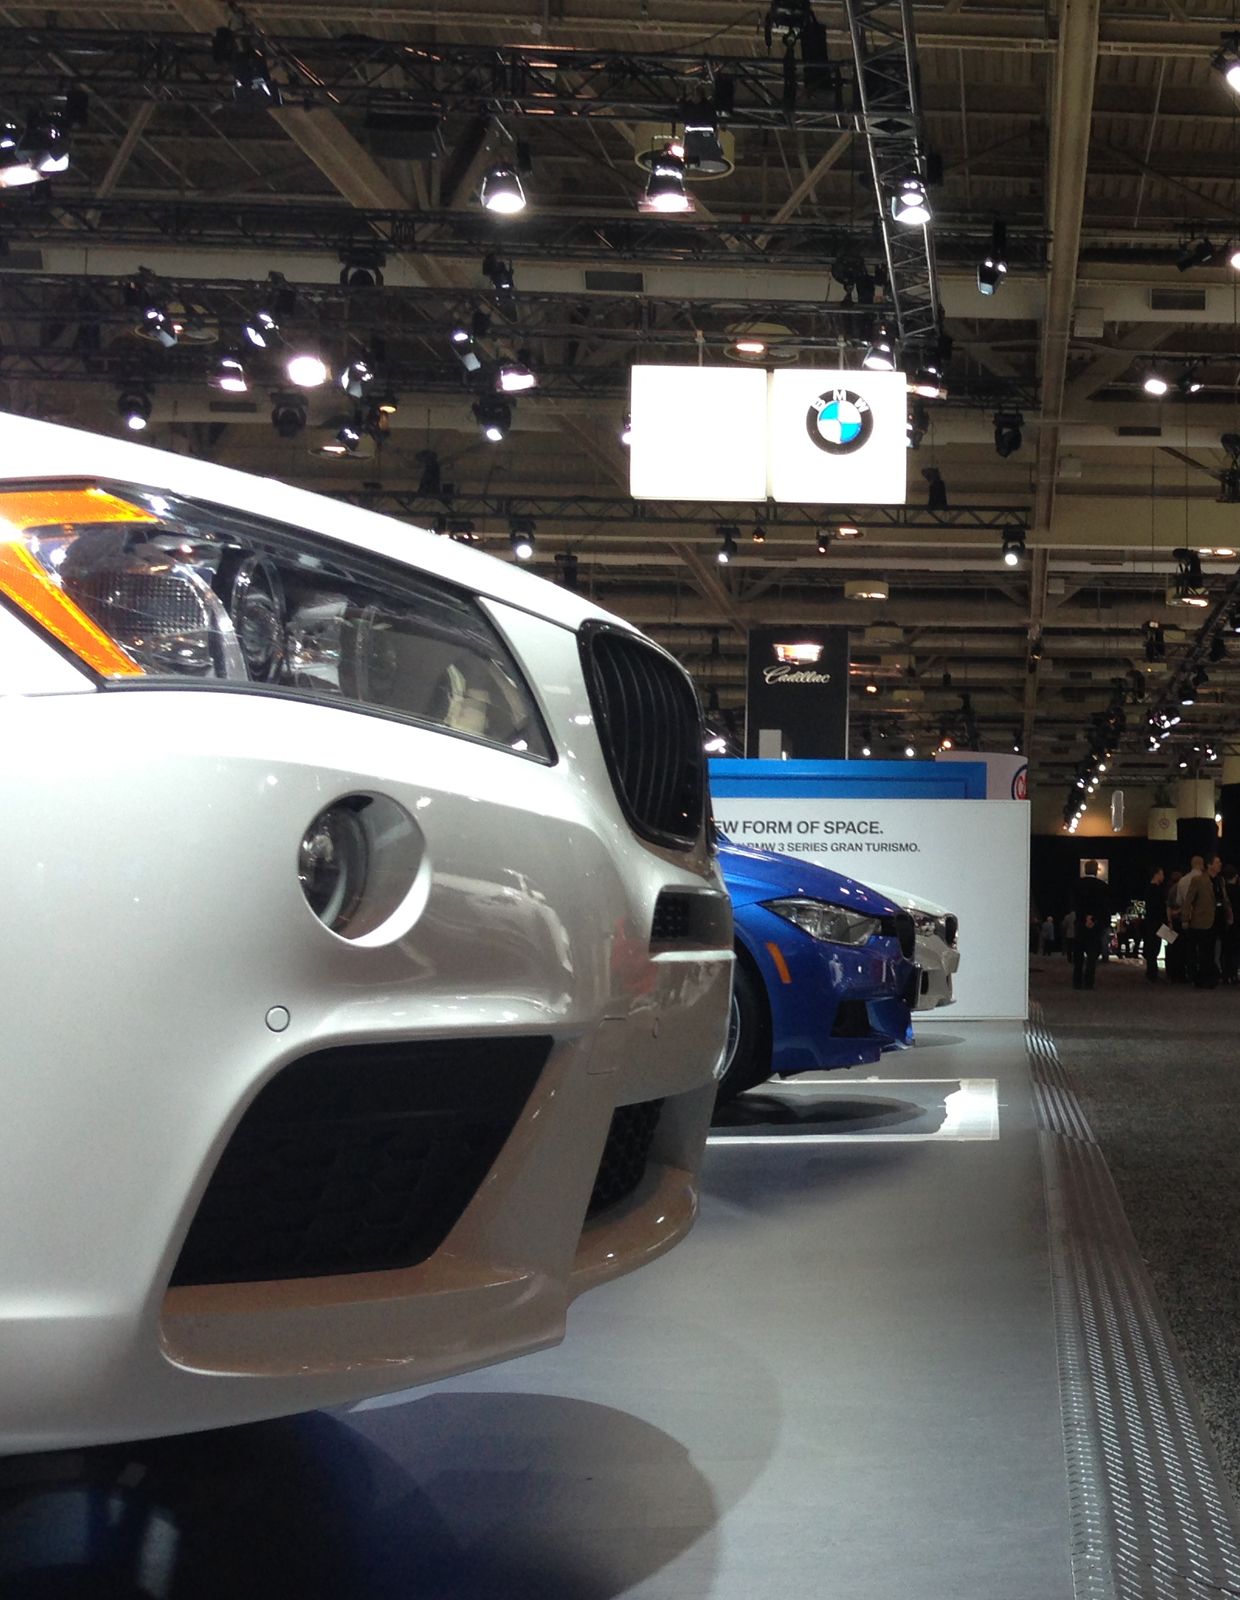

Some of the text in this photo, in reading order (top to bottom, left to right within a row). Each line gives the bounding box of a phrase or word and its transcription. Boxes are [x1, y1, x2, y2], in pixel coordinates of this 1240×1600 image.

[811, 389, 869, 412] BMW
[763, 666, 830, 684] Cadillac
[742, 821, 792, 834] FORM
[796, 820, 820, 834] OF
[823, 820, 884, 834] SPACE.
[778, 842, 785, 852] 3
[787, 842, 828, 852] SERIES
[830, 842, 863, 852] GRAN
[864, 842, 921, 852] TURISMO.
